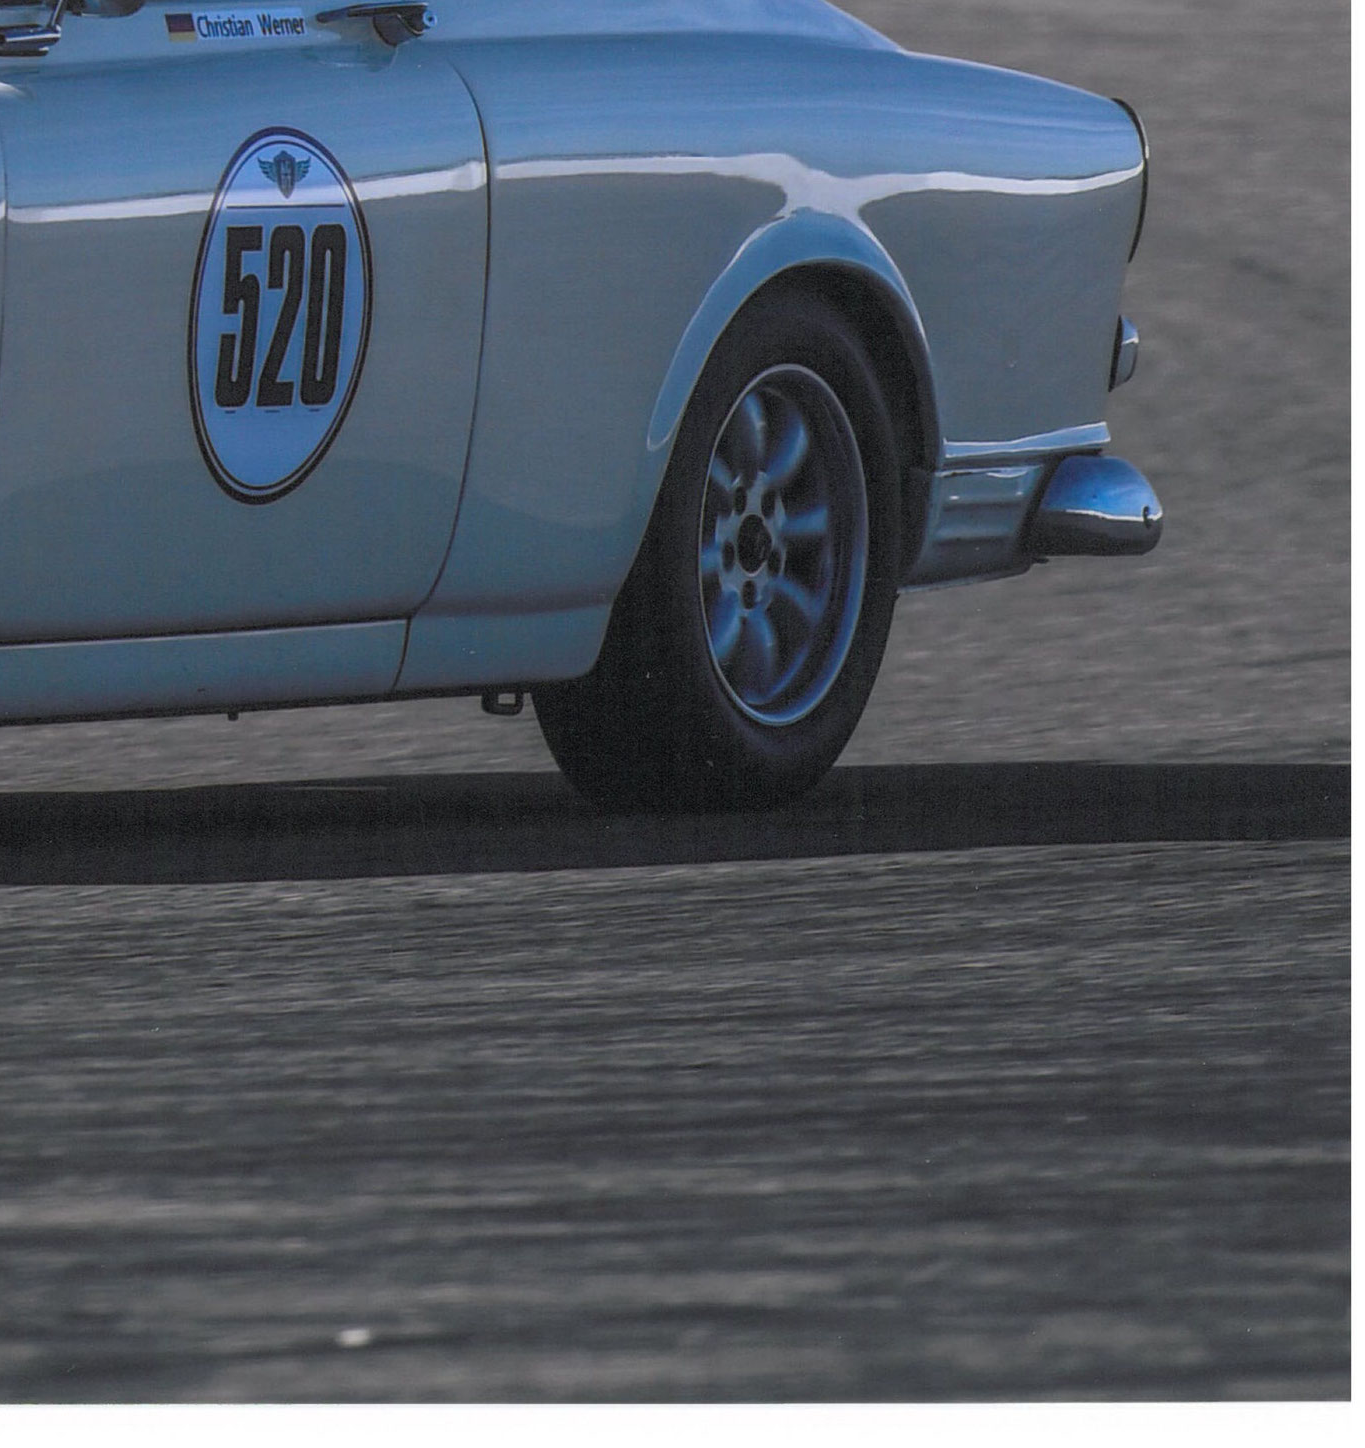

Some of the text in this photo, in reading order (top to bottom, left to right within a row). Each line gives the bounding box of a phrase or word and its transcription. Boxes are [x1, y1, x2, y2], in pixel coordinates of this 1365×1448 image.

[196, 13, 305, 38] Christian Werner
[214, 223, 347, 408] 520
